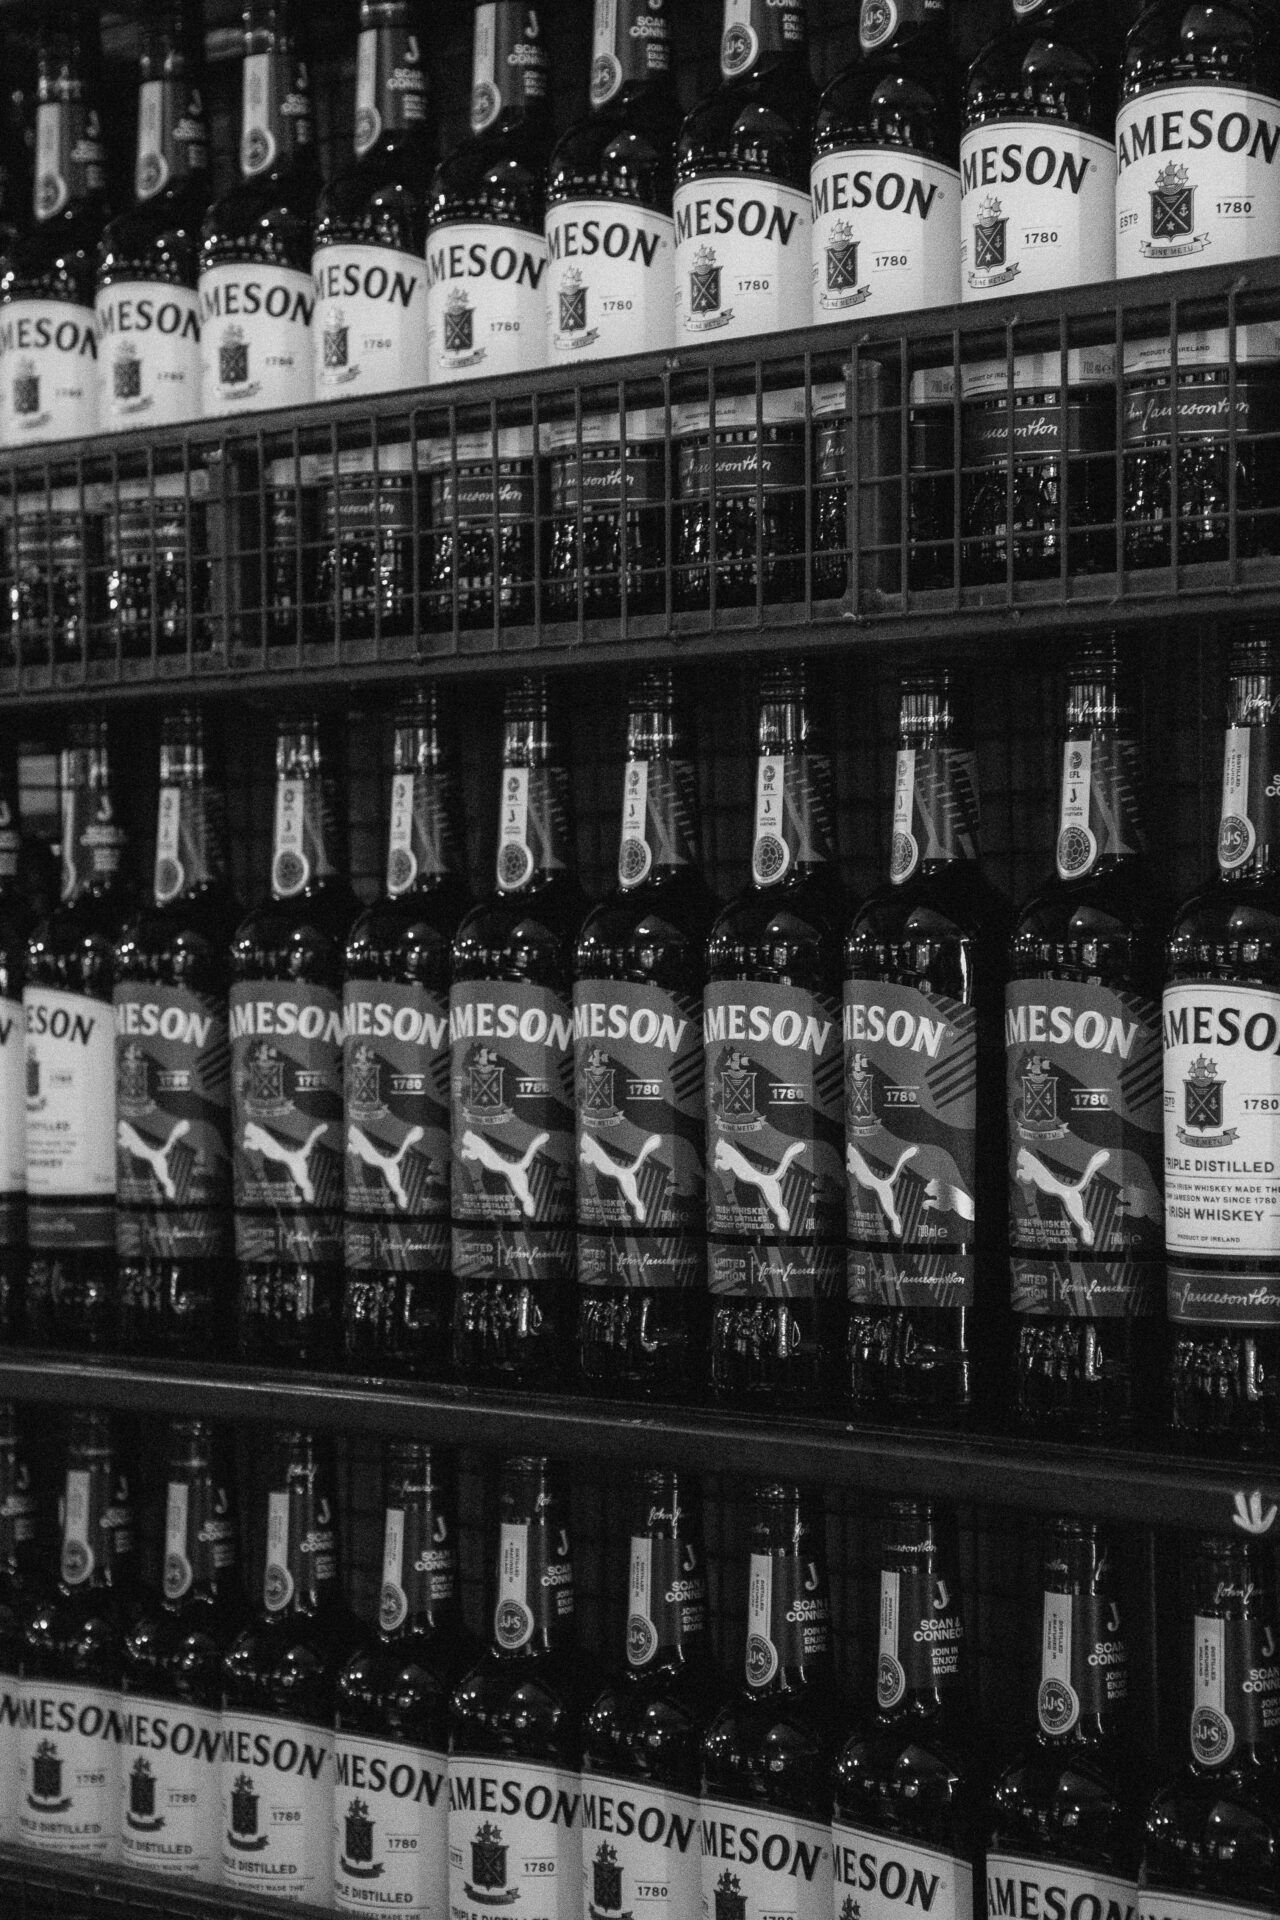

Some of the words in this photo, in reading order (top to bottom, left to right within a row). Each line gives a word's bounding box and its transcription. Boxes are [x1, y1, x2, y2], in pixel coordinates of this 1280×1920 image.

[961, 143, 1091, 199] MESON
[812, 170, 938, 225] MESON
[1216, 201, 1251, 214] 1780
[675, 197, 799, 247] MESON
[1025, 231, 1058, 245] 1780
[875, 255, 908, 268] 1780
[737, 280, 770, 292] 1780
[602, 300, 634, 311] 1780
[490, 321, 521, 332] 1780
[1005, 1004, 1139, 1060] MESON
[392, 1078, 423, 1090] 1780
[629, 1083, 660, 1095] 1780
[772, 1088, 805, 1100] 1780
[886, 1090, 917, 1102] 1780
[1074, 1093, 1108, 1106] 1780
[1243, 1099, 1279, 1110] 1780
[1195, 1160, 1275, 1173] DISTILLED
[1194, 1208, 1264, 1222] WHISKEY
[920, 1618, 953, 1630] SCAN
[913, 1627, 963, 1642] CONNEC
[931, 1648, 950, 1656] JOIN
[932, 1655, 958, 1665] ENJOY
[271, 1811, 301, 1821] 1780
[136, 1841, 193, 1855] DISTILLED
[387, 1838, 418, 1849] 1780
[238, 1861, 298, 1875] DISTILLED
[523, 1862, 555, 1873] 1780
[352, 1888, 414, 1903] DISTILLED
[637, 1886, 668, 1897] 1780
